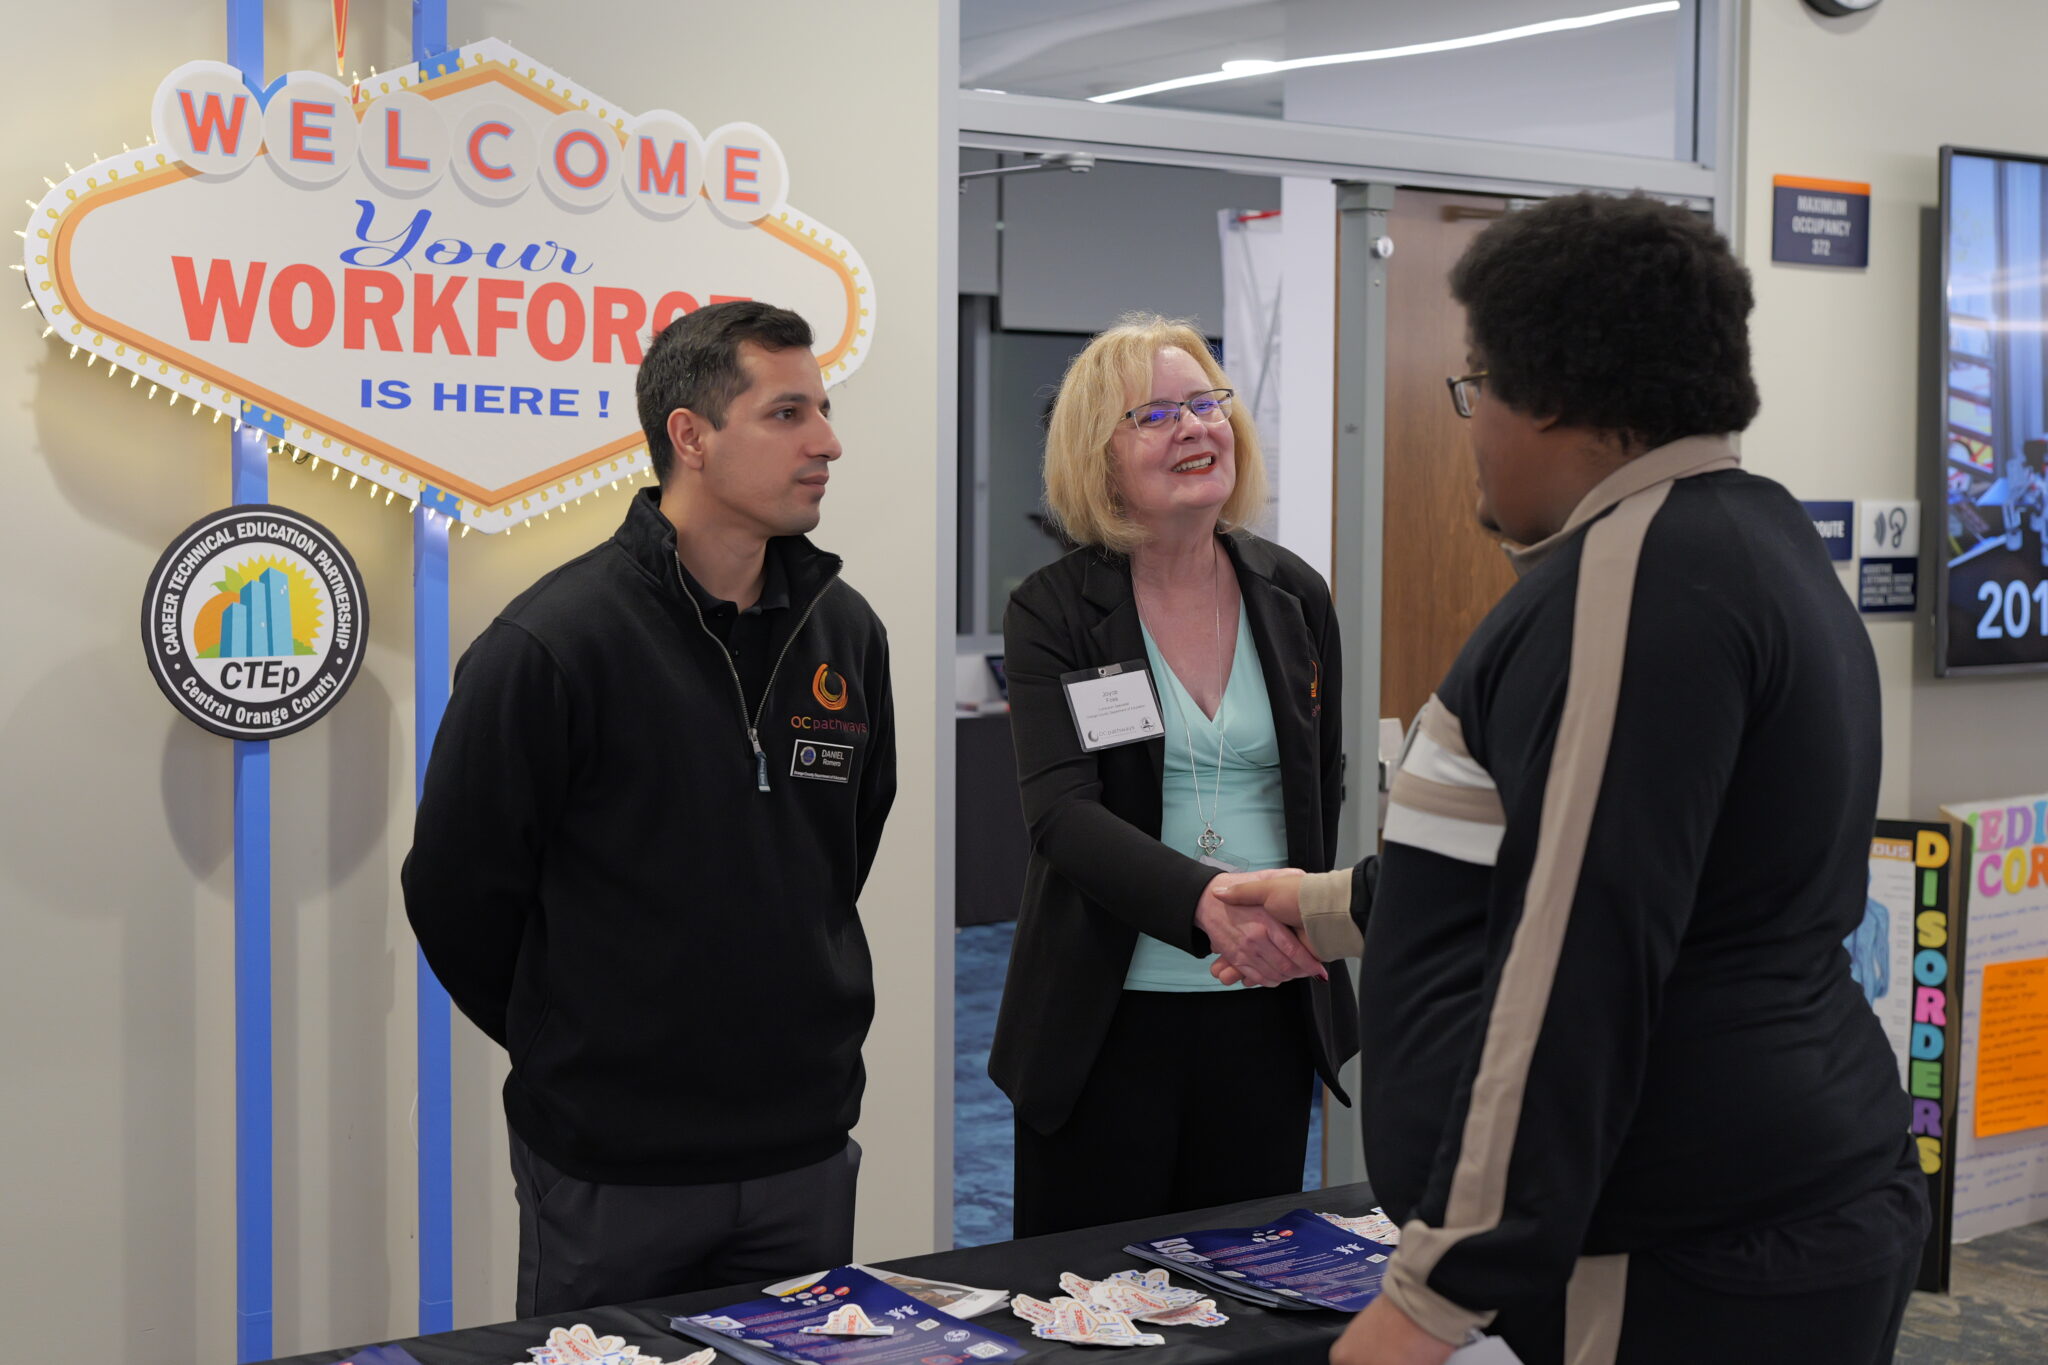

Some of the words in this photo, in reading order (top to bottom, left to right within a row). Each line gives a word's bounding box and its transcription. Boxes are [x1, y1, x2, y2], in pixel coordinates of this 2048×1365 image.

[177, 88, 763, 205] WELCOME
[1791, 215, 1851, 238] OCCUPANCY
[1797, 195, 1848, 216] MAXIMUM
[340, 200, 593, 275] Your
[171, 255, 753, 366] WORKFOR
[360, 378, 412, 410] IS
[432, 383, 581, 418] HERE
[168, 527, 235, 591] TECHNICAL
[236, 521, 319, 556] EDUCATION
[161, 594, 180, 656] CAREER
[314, 549, 352, 650] PARTNERSHIP
[1976, 580, 2048, 639] 201
[182, 676, 233, 720] Central
[235, 707, 289, 726] Orange
[291, 672, 338, 714] County
[220, 660, 300, 694] CTEp
[821, 749, 845, 760] DANIEL
[1967, 800, 2048, 853] EDI
[1911, 829, 1950, 1175] DISORDERS
